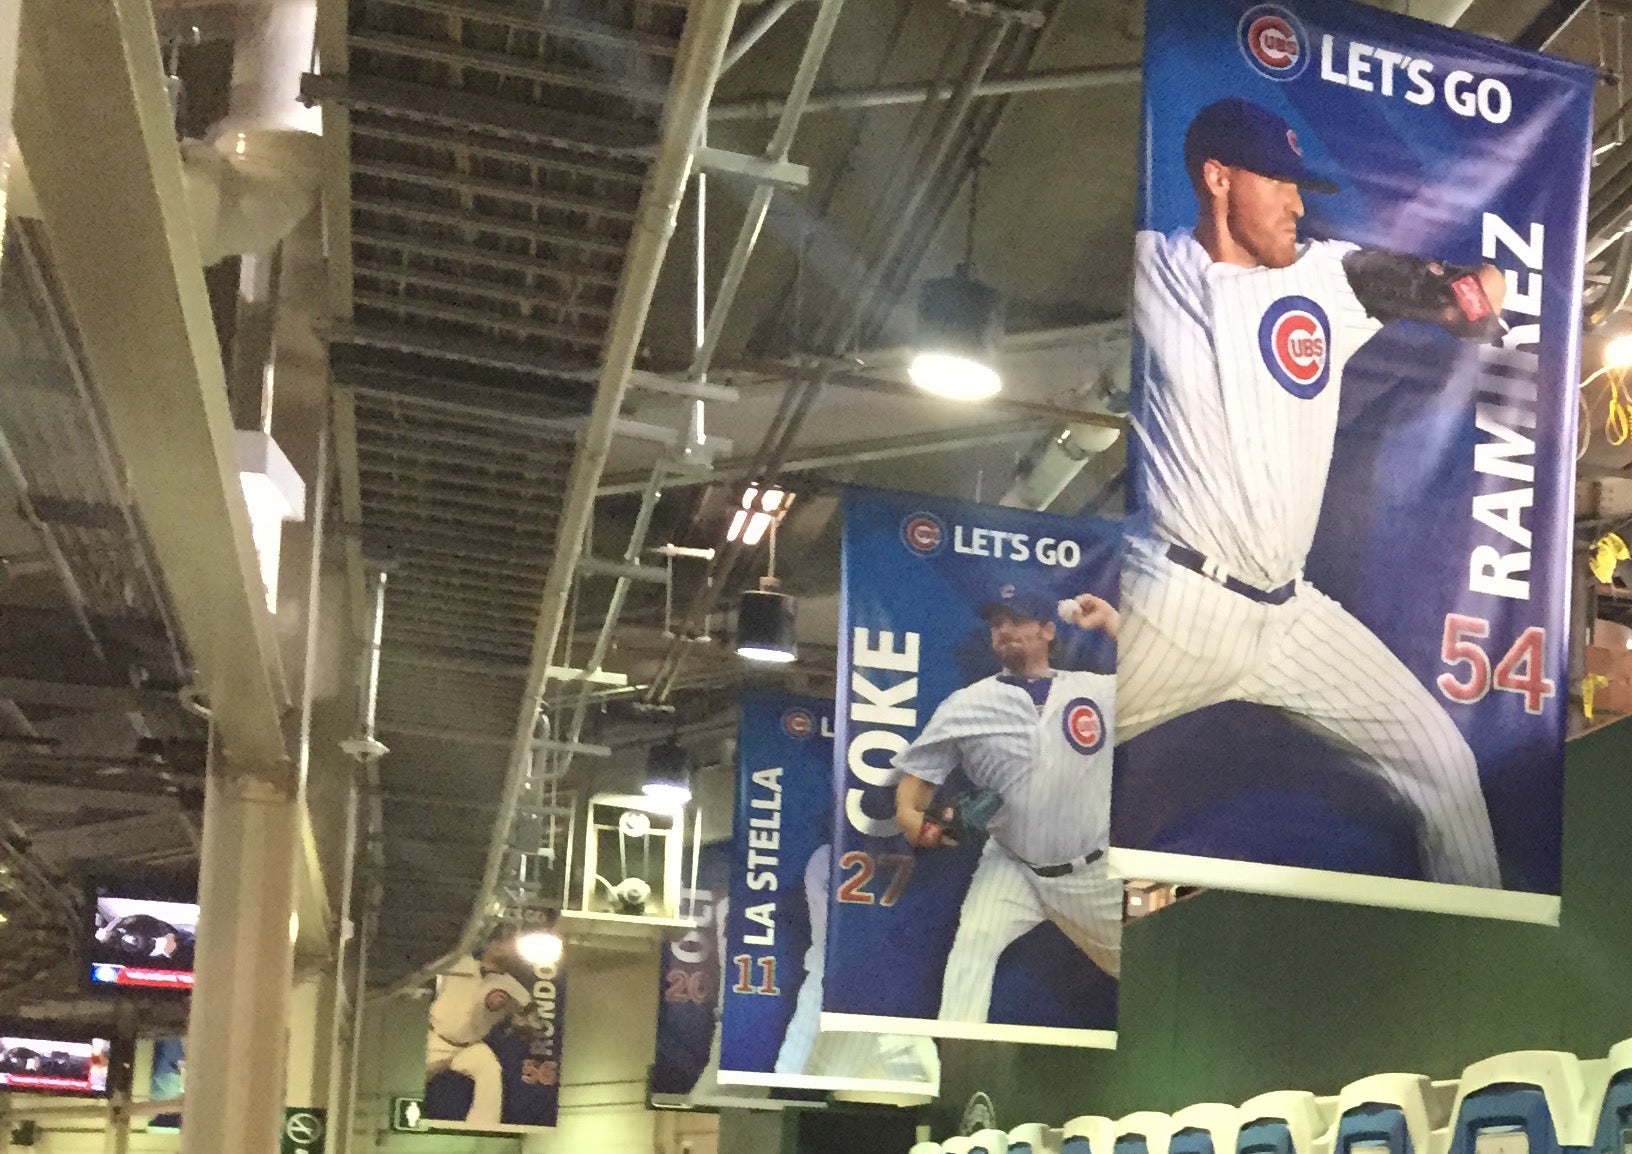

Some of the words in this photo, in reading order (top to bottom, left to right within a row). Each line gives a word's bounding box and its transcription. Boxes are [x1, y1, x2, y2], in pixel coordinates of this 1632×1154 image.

[1320, 33, 1436, 106] LET'S
[1443, 69, 1513, 124] GO
[953, 525, 1030, 562] LET'S
[1034, 537, 1082, 568] GO
[1436, 613, 1557, 715] 54
[845, 626, 921, 838] COKE
[745, 766, 784, 892] STELLA
[838, 850, 916, 907] 27
[742, 902, 777, 946] LA
[733, 953, 781, 995] 11
